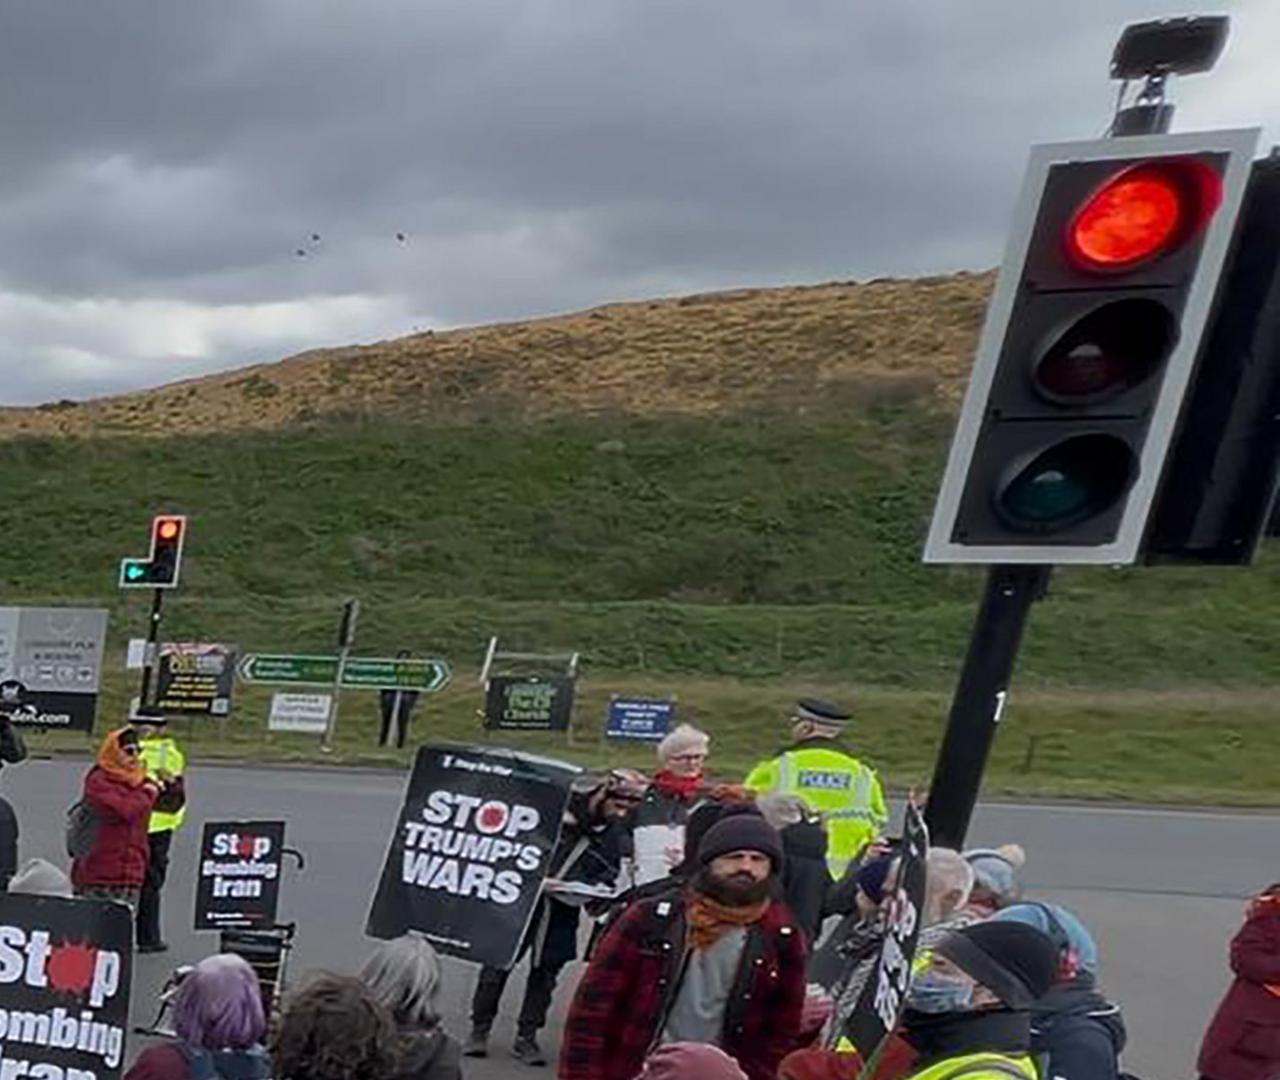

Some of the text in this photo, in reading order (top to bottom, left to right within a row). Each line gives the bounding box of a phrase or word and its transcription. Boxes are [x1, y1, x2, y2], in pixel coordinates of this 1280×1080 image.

[423, 790, 540, 837] STOP
[405, 821, 543, 871] TRUMP'S
[213, 876, 262, 897] Iran
[402, 850, 523, 904] WARS
